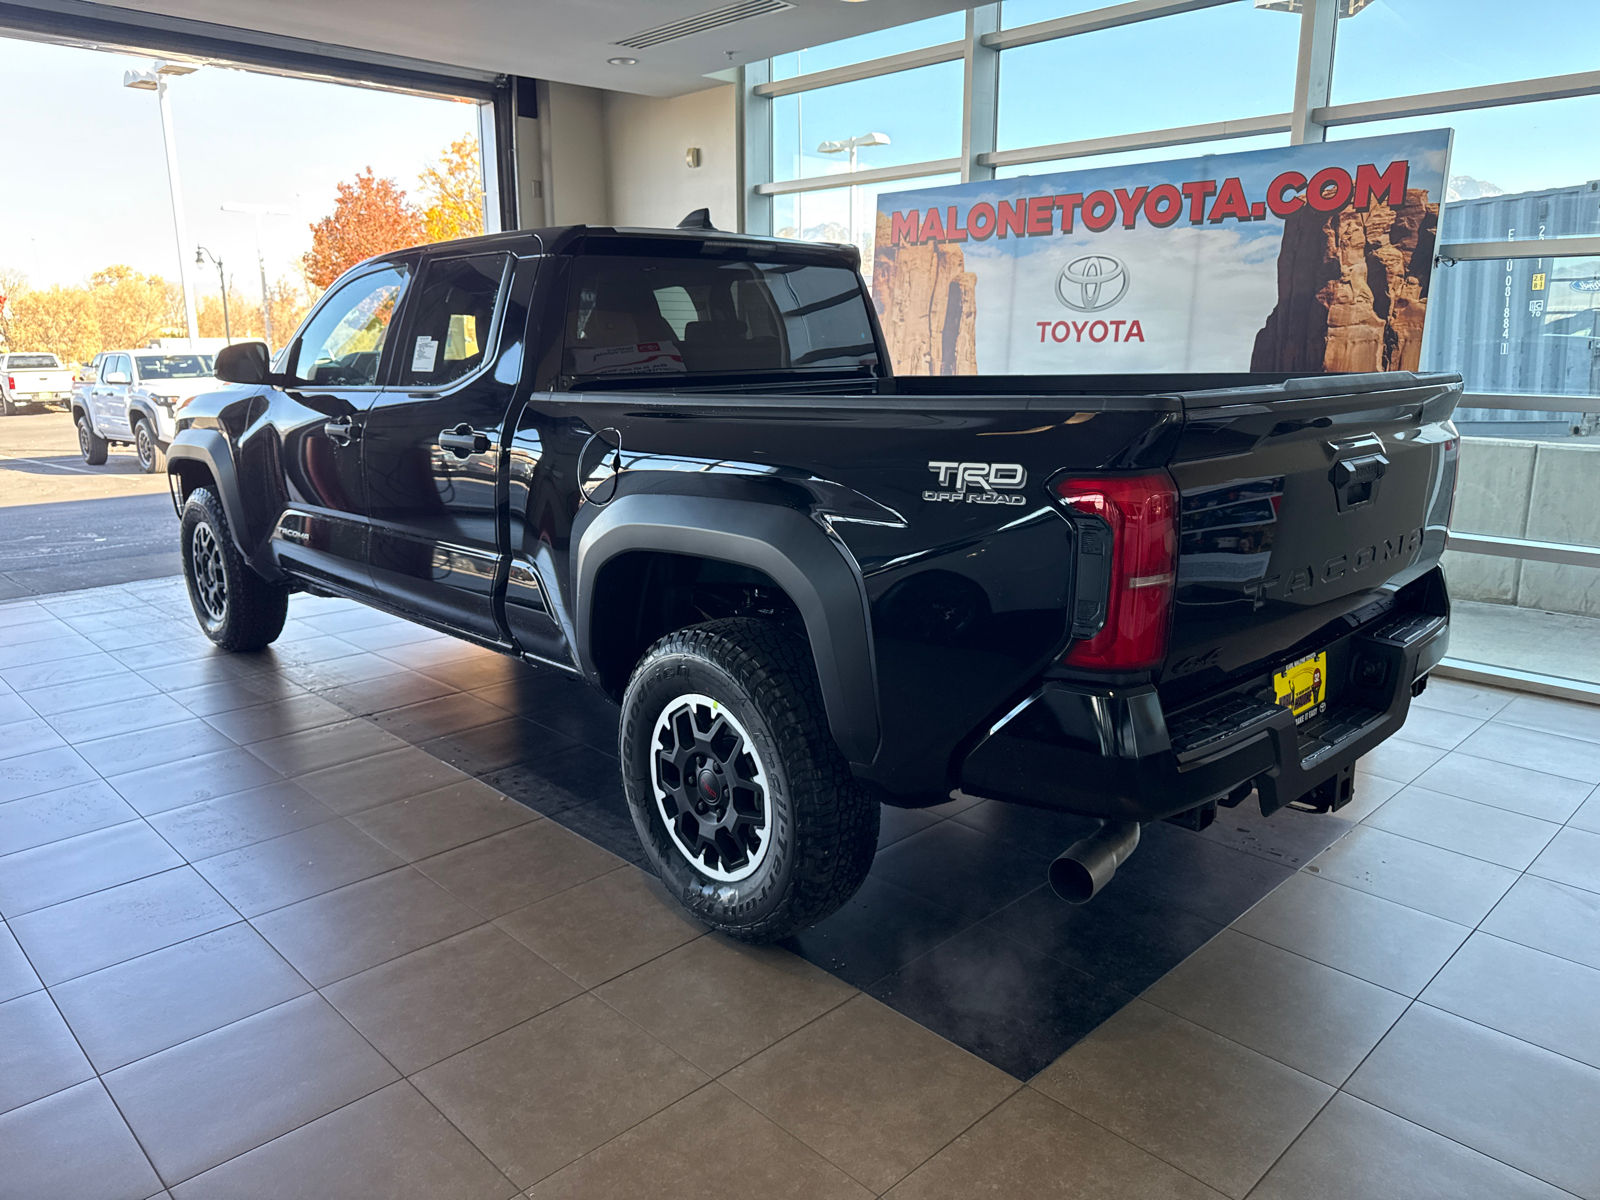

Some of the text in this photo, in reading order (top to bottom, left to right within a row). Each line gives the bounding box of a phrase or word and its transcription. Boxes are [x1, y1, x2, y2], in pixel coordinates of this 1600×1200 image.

[891, 160, 1409, 246] MALONETOYOTA.COM
[1036, 320, 1145, 343] TOYOTA
[928, 461, 1027, 493] TRD
[922, 490, 1026, 505] OFF ROAD
[1243, 527, 1424, 612] TACOMA
